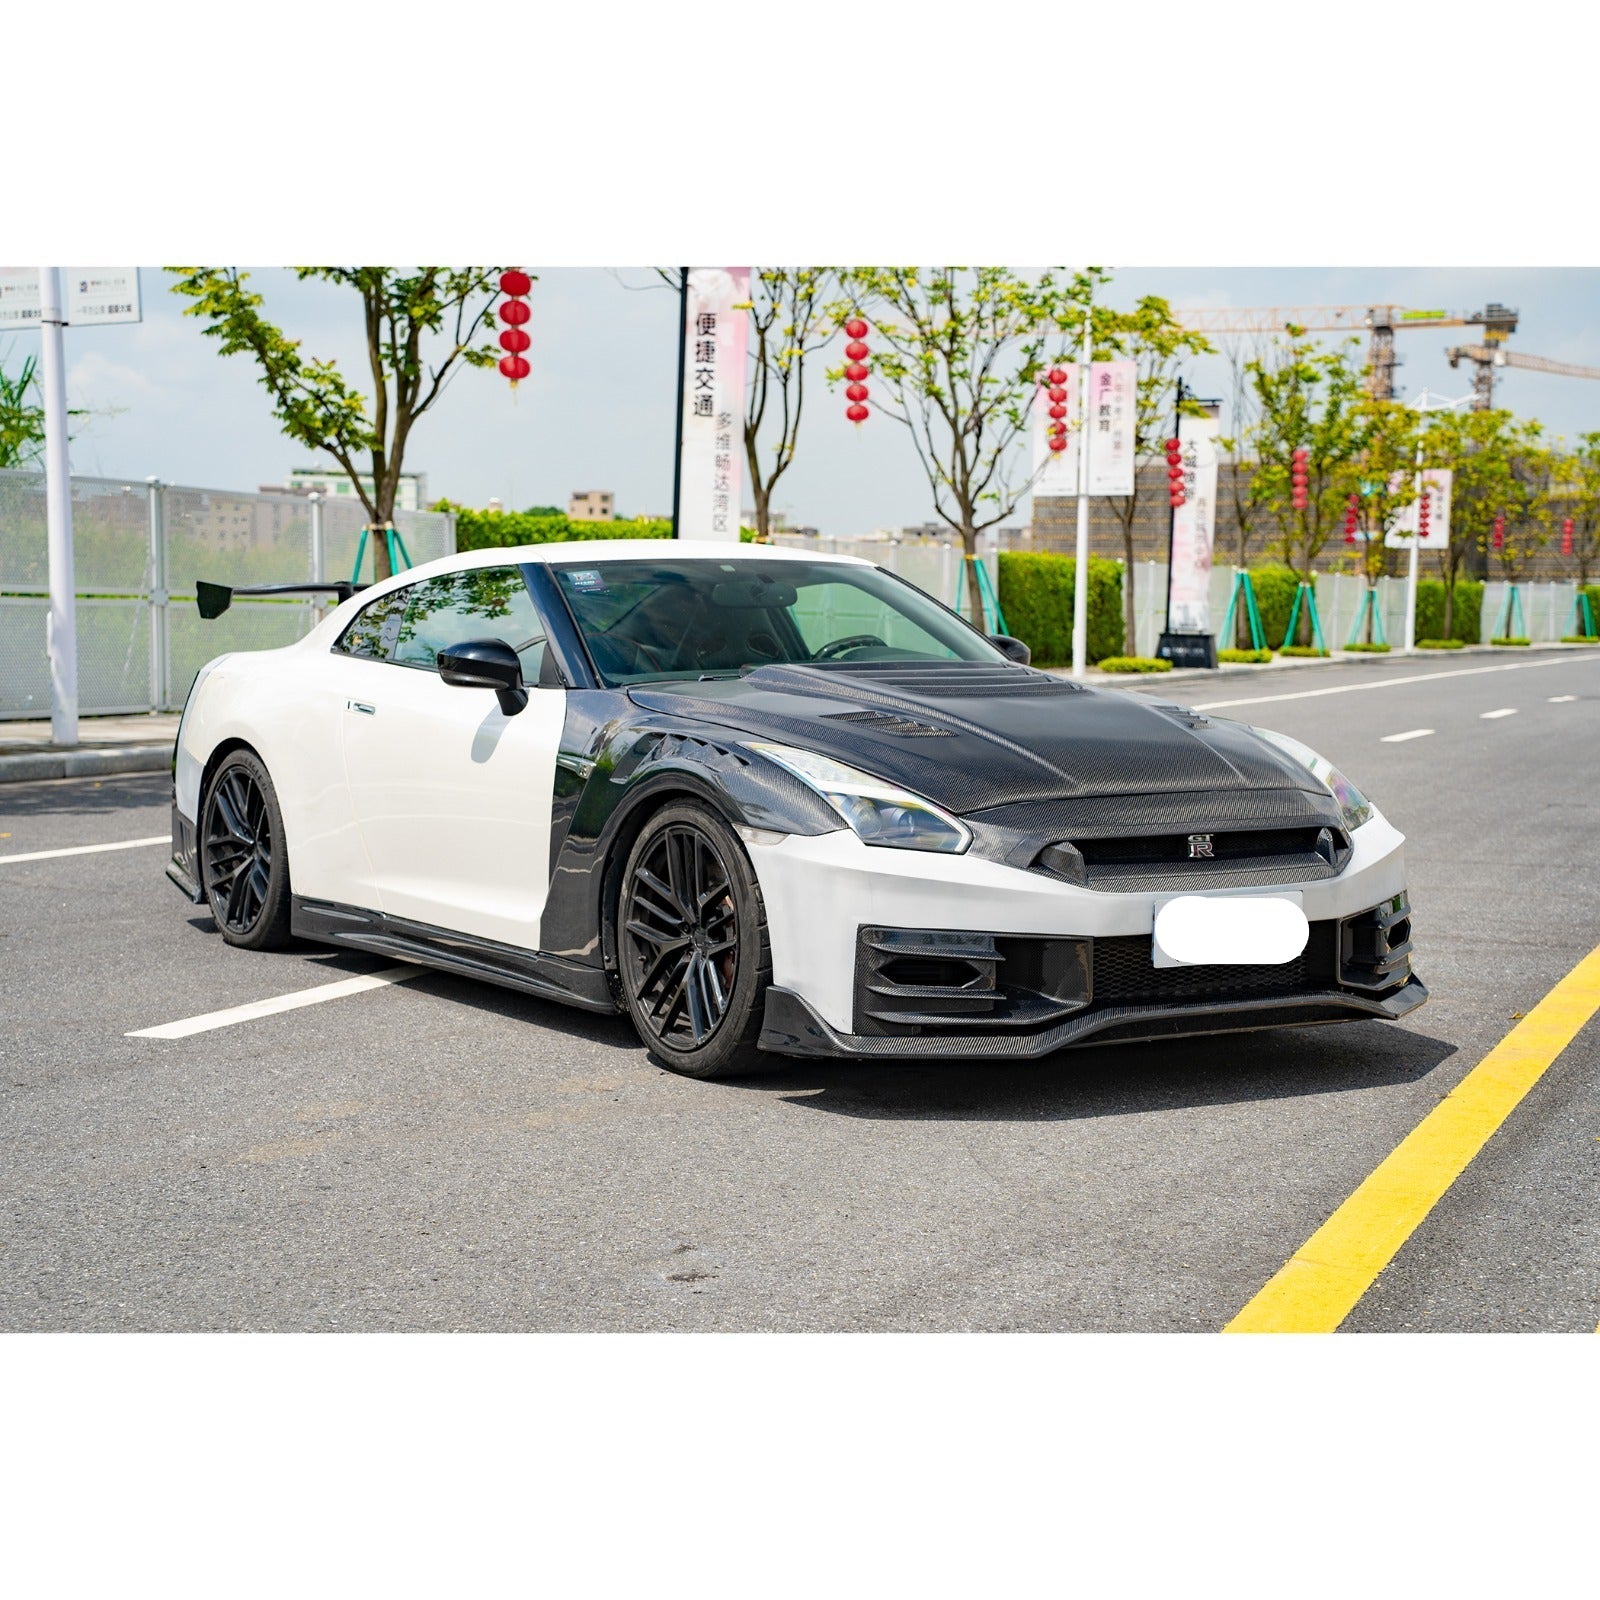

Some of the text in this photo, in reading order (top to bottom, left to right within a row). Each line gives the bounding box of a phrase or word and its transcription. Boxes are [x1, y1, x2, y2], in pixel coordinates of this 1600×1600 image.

[695, 313, 716, 417] 便捷交通
[1188, 833, 1214, 843] GT
